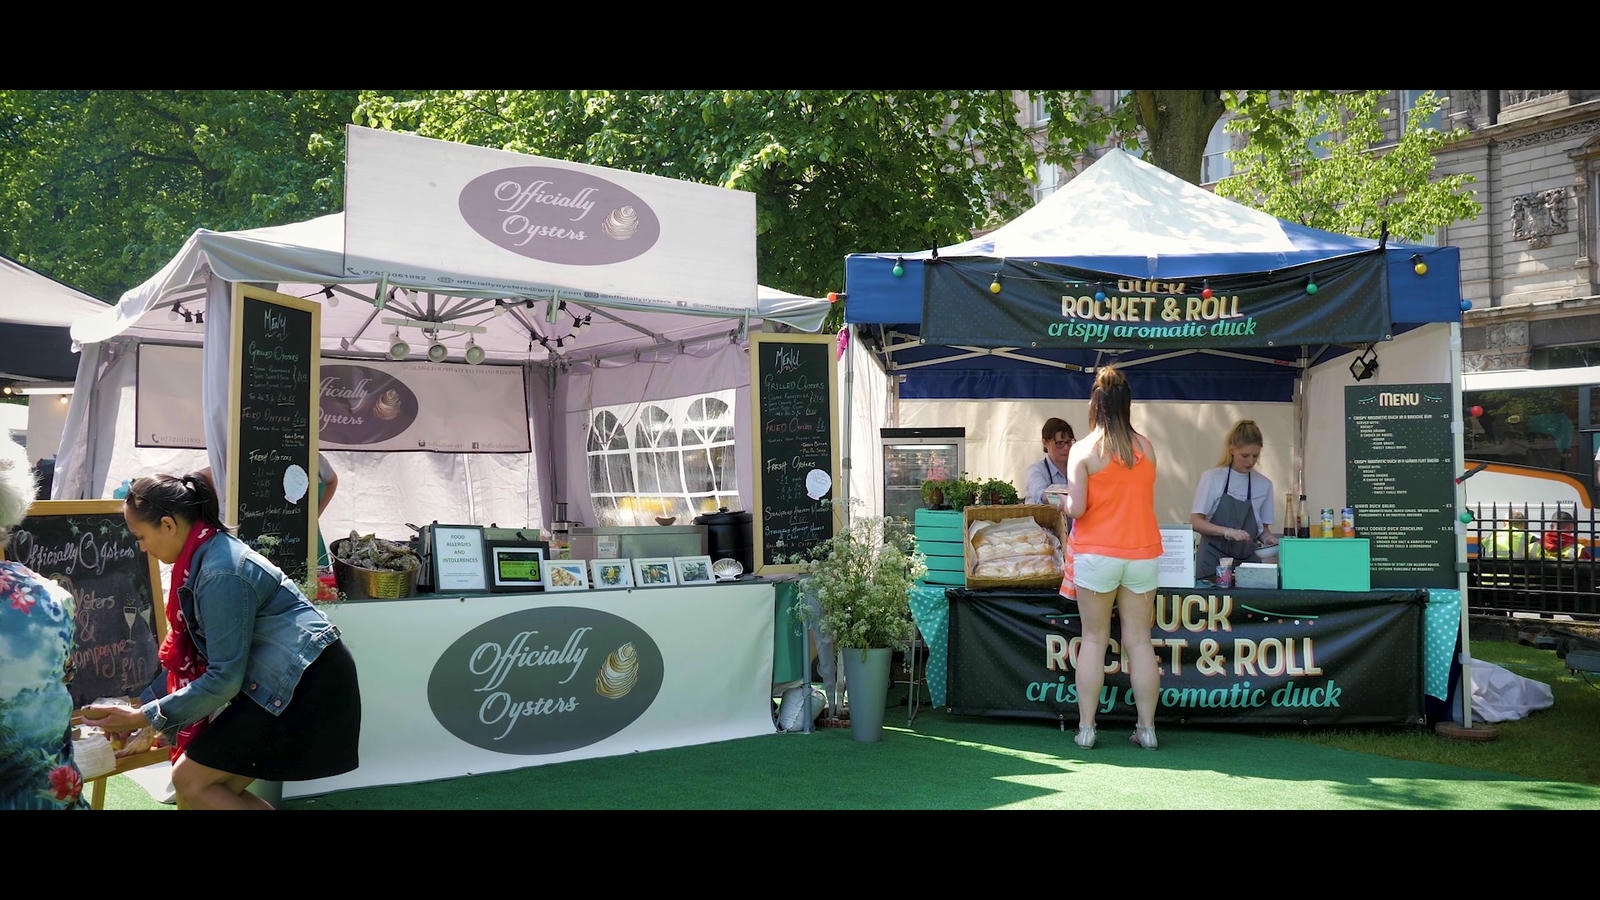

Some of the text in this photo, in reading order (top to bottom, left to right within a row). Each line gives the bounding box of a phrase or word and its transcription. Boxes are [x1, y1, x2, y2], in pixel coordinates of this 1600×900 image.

[494, 180, 599, 222] Officially
[502, 215, 589, 246] Oysters
[1118, 279, 1186, 295] DUCK
[1061, 295, 1244, 322] ROCKET & ROLL
[1048, 316, 1257, 343] crispy aromatic duck
[1379, 392, 1420, 406] MENU
[319, 407, 365, 432] ysters
[1151, 594, 1233, 632] UCK
[468, 627, 593, 692] Officially
[1196, 638, 1227, 676] &
[1234, 637, 1323, 676] ROLL
[1026, 676, 1342, 713] crisy aomatic duck
[478, 692, 580, 741] Oysters
